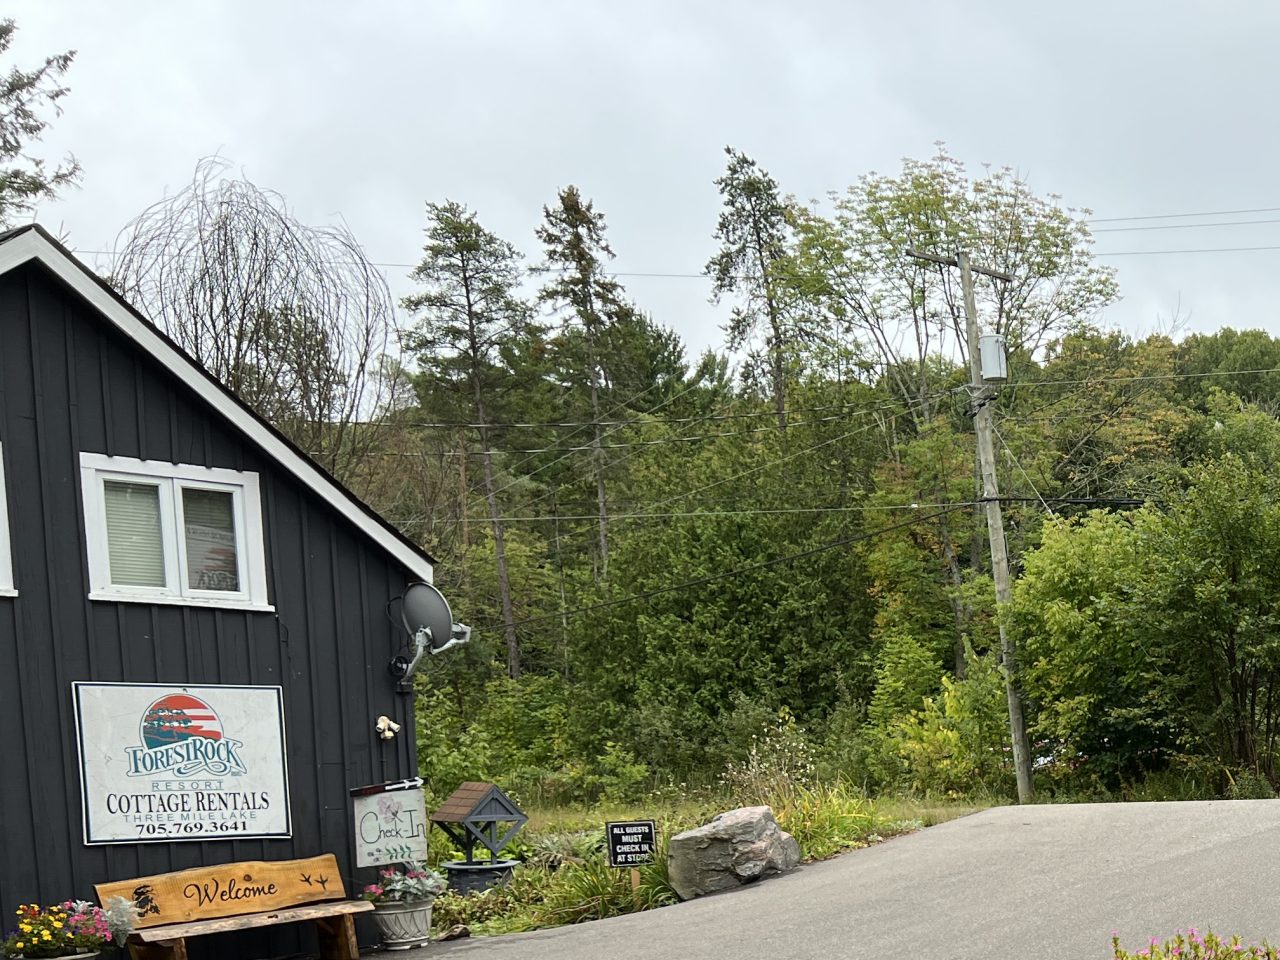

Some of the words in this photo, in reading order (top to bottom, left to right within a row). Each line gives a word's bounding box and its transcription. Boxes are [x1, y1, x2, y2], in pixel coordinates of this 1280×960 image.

[152, 781, 224, 791] RESORT
[106, 793, 191, 814] COTTAGE
[196, 792, 270, 811] RENTALS
[124, 813, 174, 823] THREE
[181, 812, 214, 821] MILE
[221, 811, 257, 820] LAKE
[135, 821, 248, 835] 705.769.3641
[621, 834, 643, 842] MUST
[616, 844, 640, 852] CHECK
[617, 854, 626, 862] AT
[183, 878, 278, 907] Welcome
